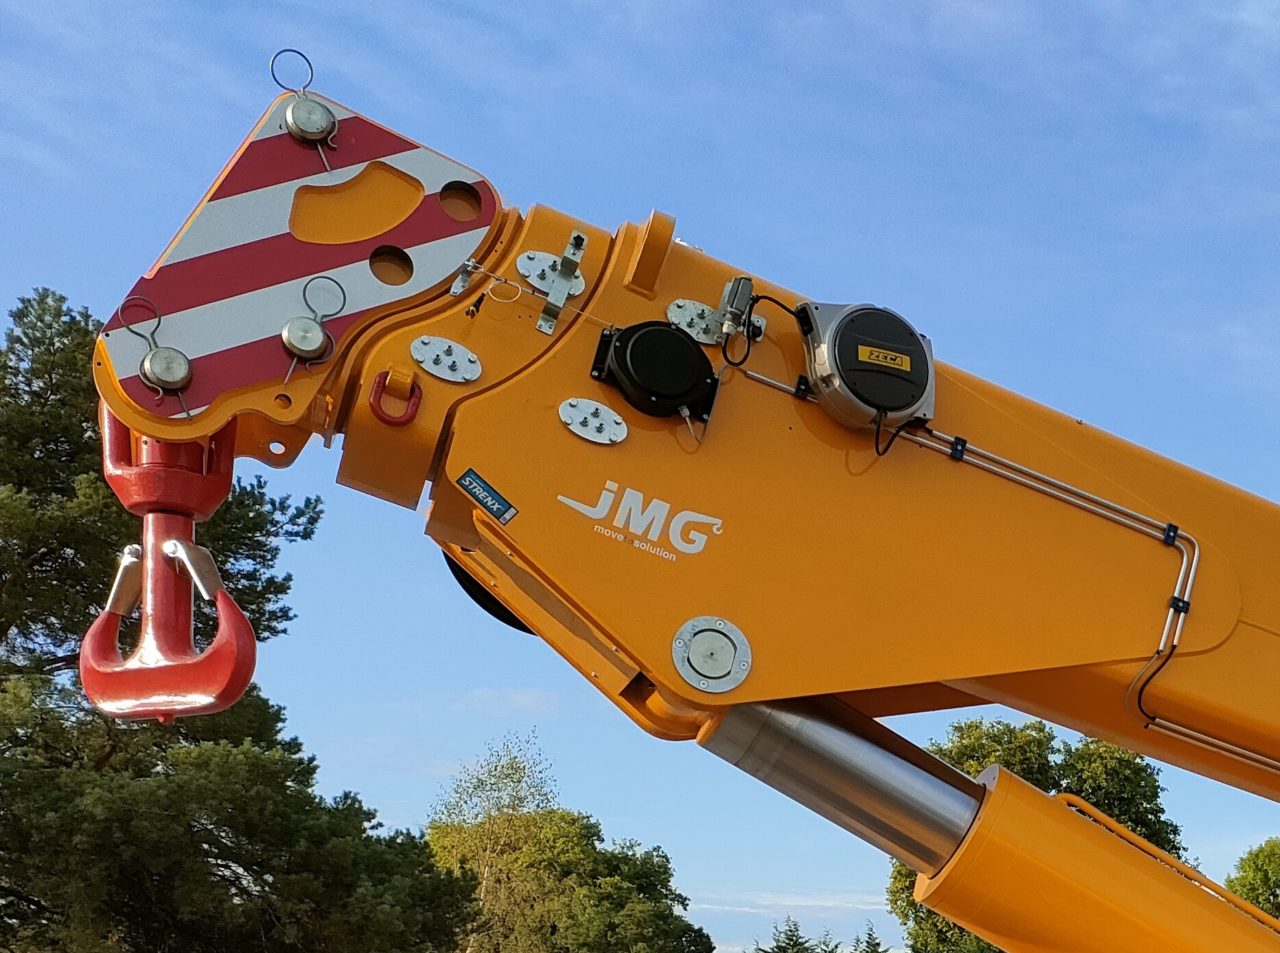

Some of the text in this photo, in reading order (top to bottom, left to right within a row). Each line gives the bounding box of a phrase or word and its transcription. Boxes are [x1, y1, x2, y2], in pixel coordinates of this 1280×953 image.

[868, 350, 903, 366] ZECA
[461, 477, 502, 511] STRENX
[593, 524, 625, 541] move
[633, 539, 676, 561] solution
